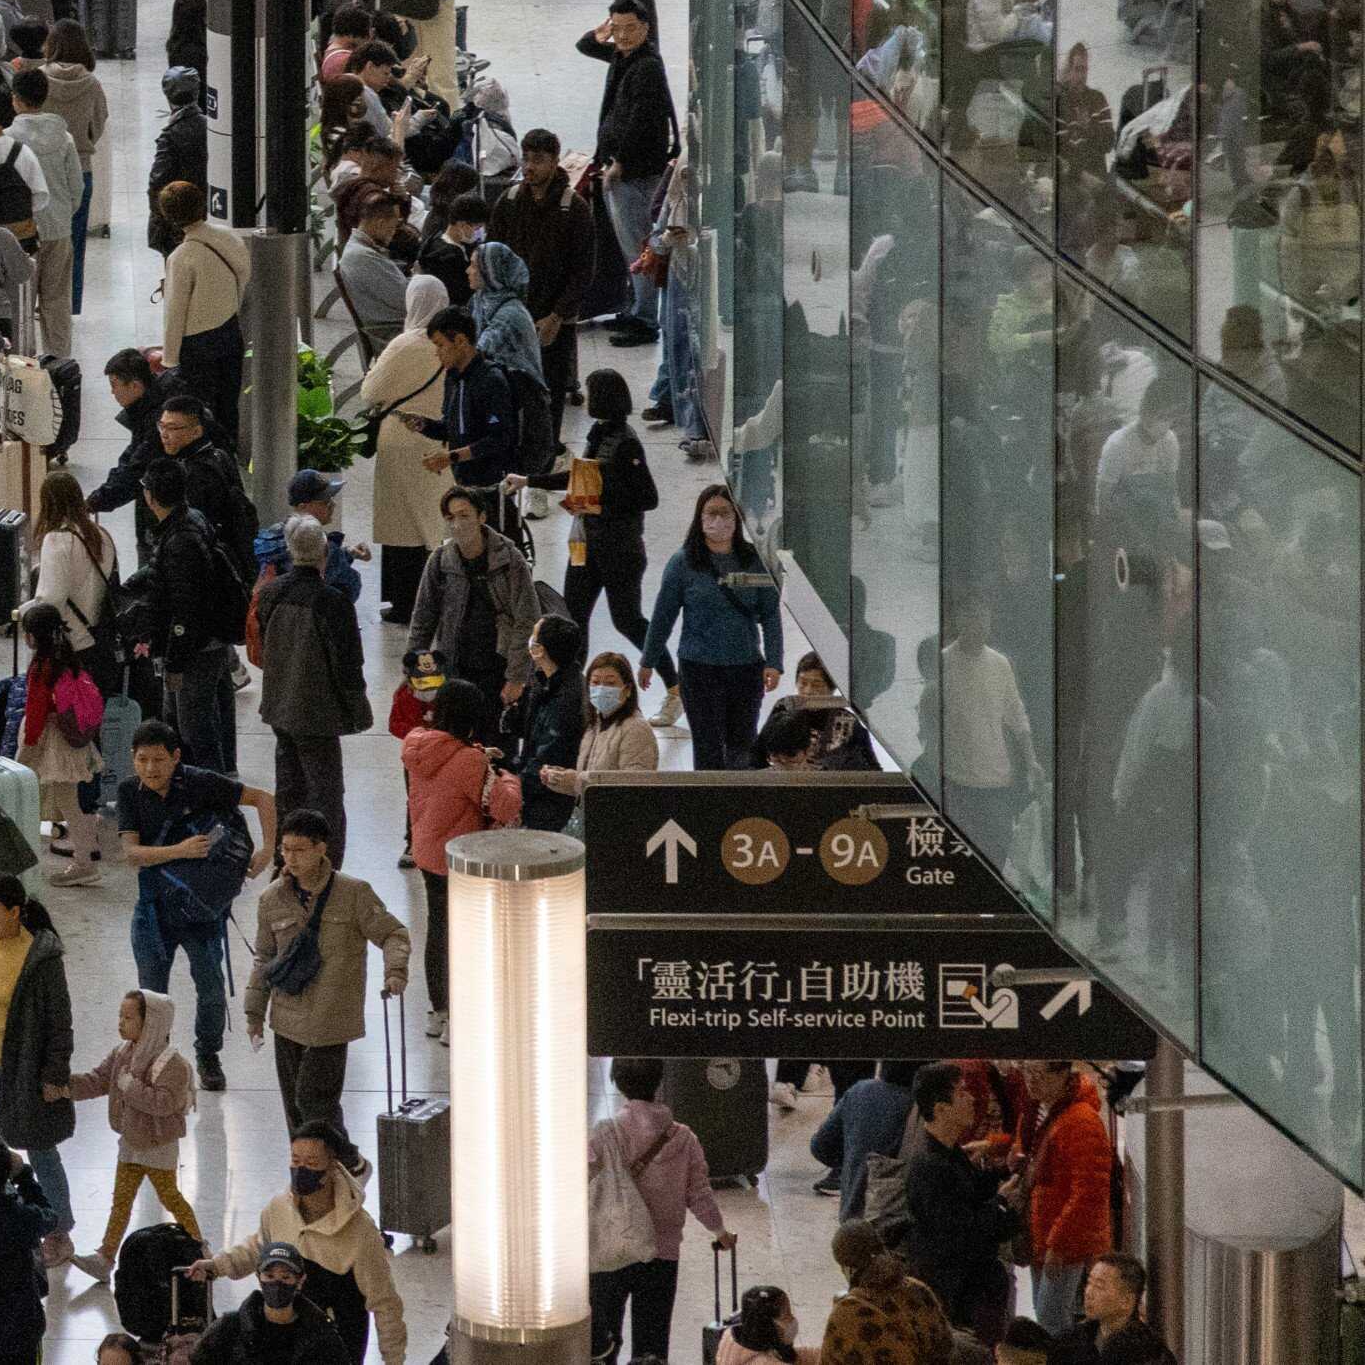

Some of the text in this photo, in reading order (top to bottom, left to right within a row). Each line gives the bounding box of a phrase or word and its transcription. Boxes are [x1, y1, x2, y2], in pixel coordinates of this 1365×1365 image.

[730, 833, 780, 869] 3A
[830, 834, 880, 870] 9A
[906, 866, 955, 886] Gate
[637, 957, 926, 1004] 「靈活行」自助機
[649, 1007, 926, 1031] Flexi-trip Self-service Point
